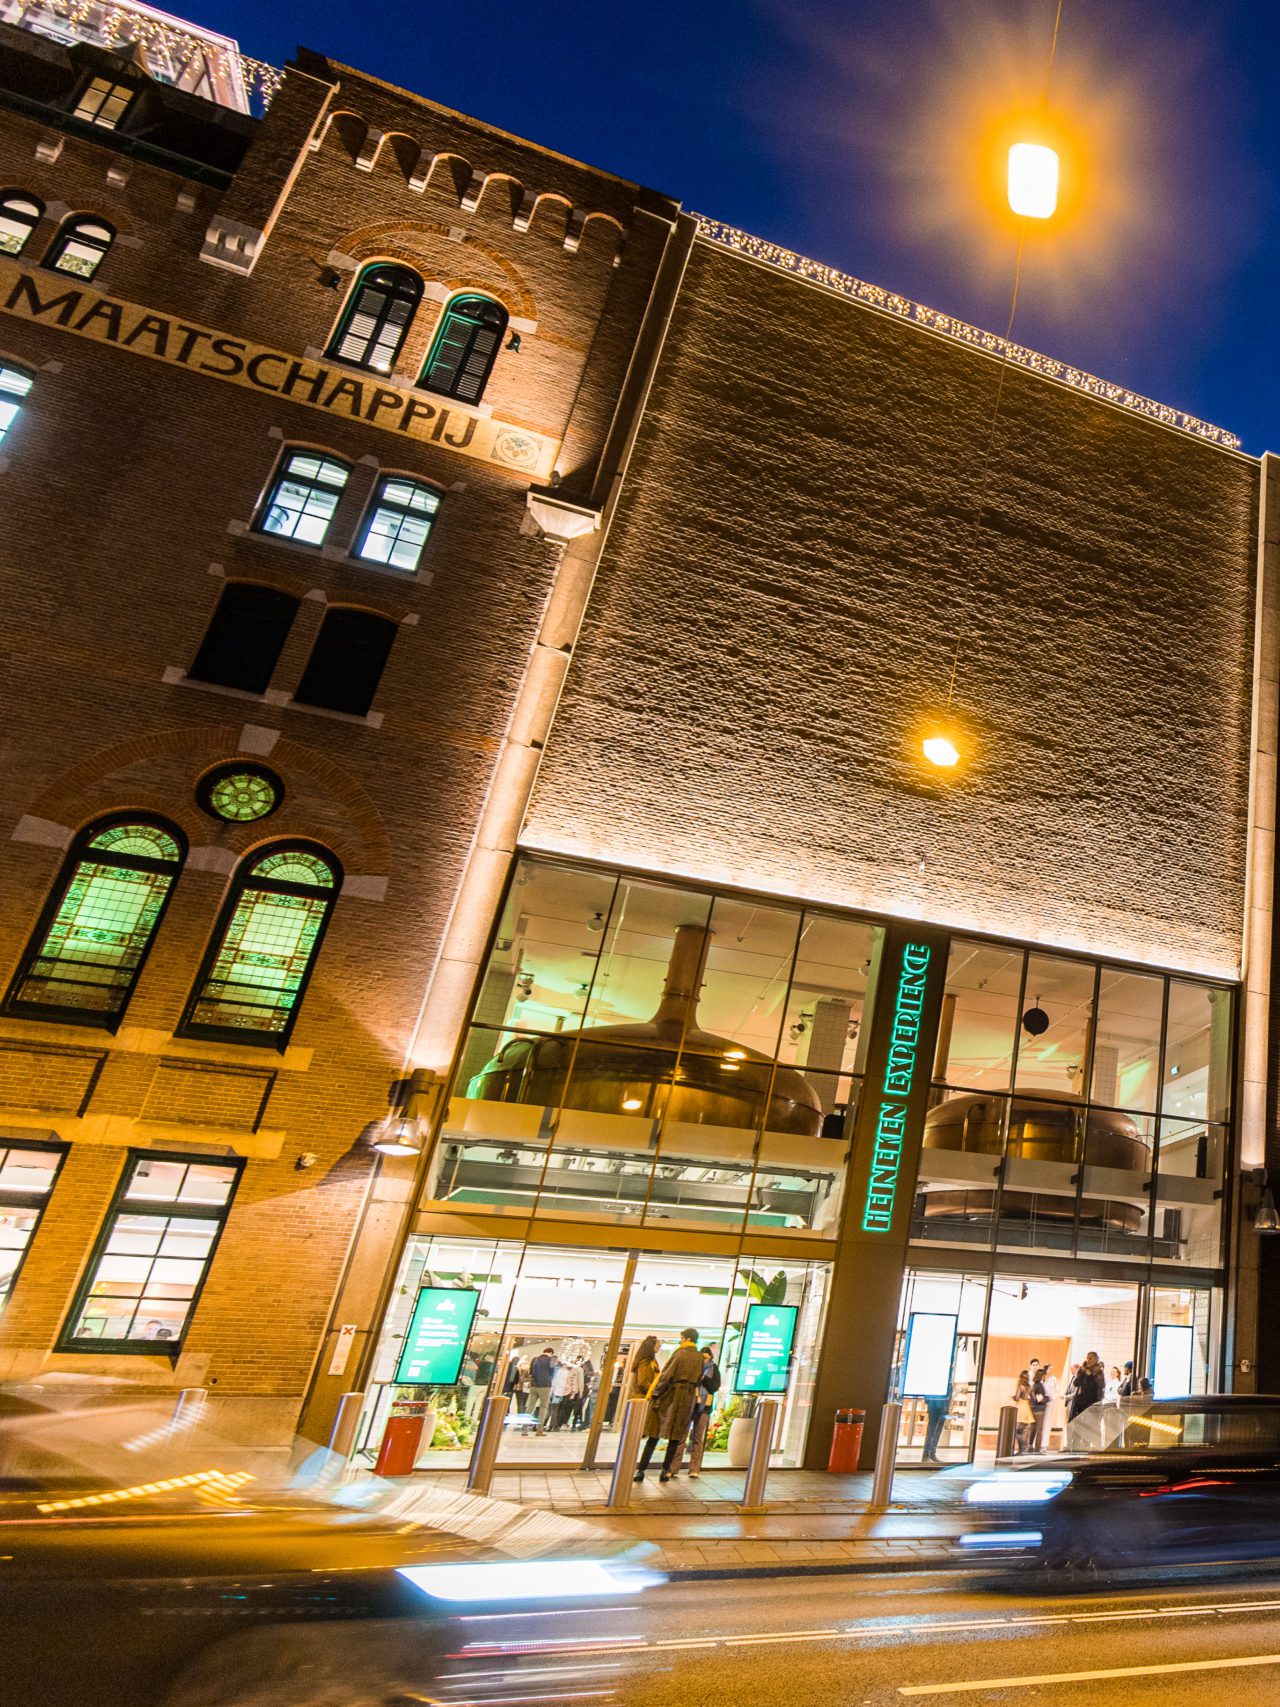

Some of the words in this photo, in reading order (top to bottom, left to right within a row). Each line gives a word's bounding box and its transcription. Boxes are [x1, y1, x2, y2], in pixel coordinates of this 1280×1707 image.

[7, 273, 479, 449] MAATSCHAPPIJ
[883, 943, 931, 1096] EXPERIENCE
[862, 1102, 907, 1232] HEINEKEN
